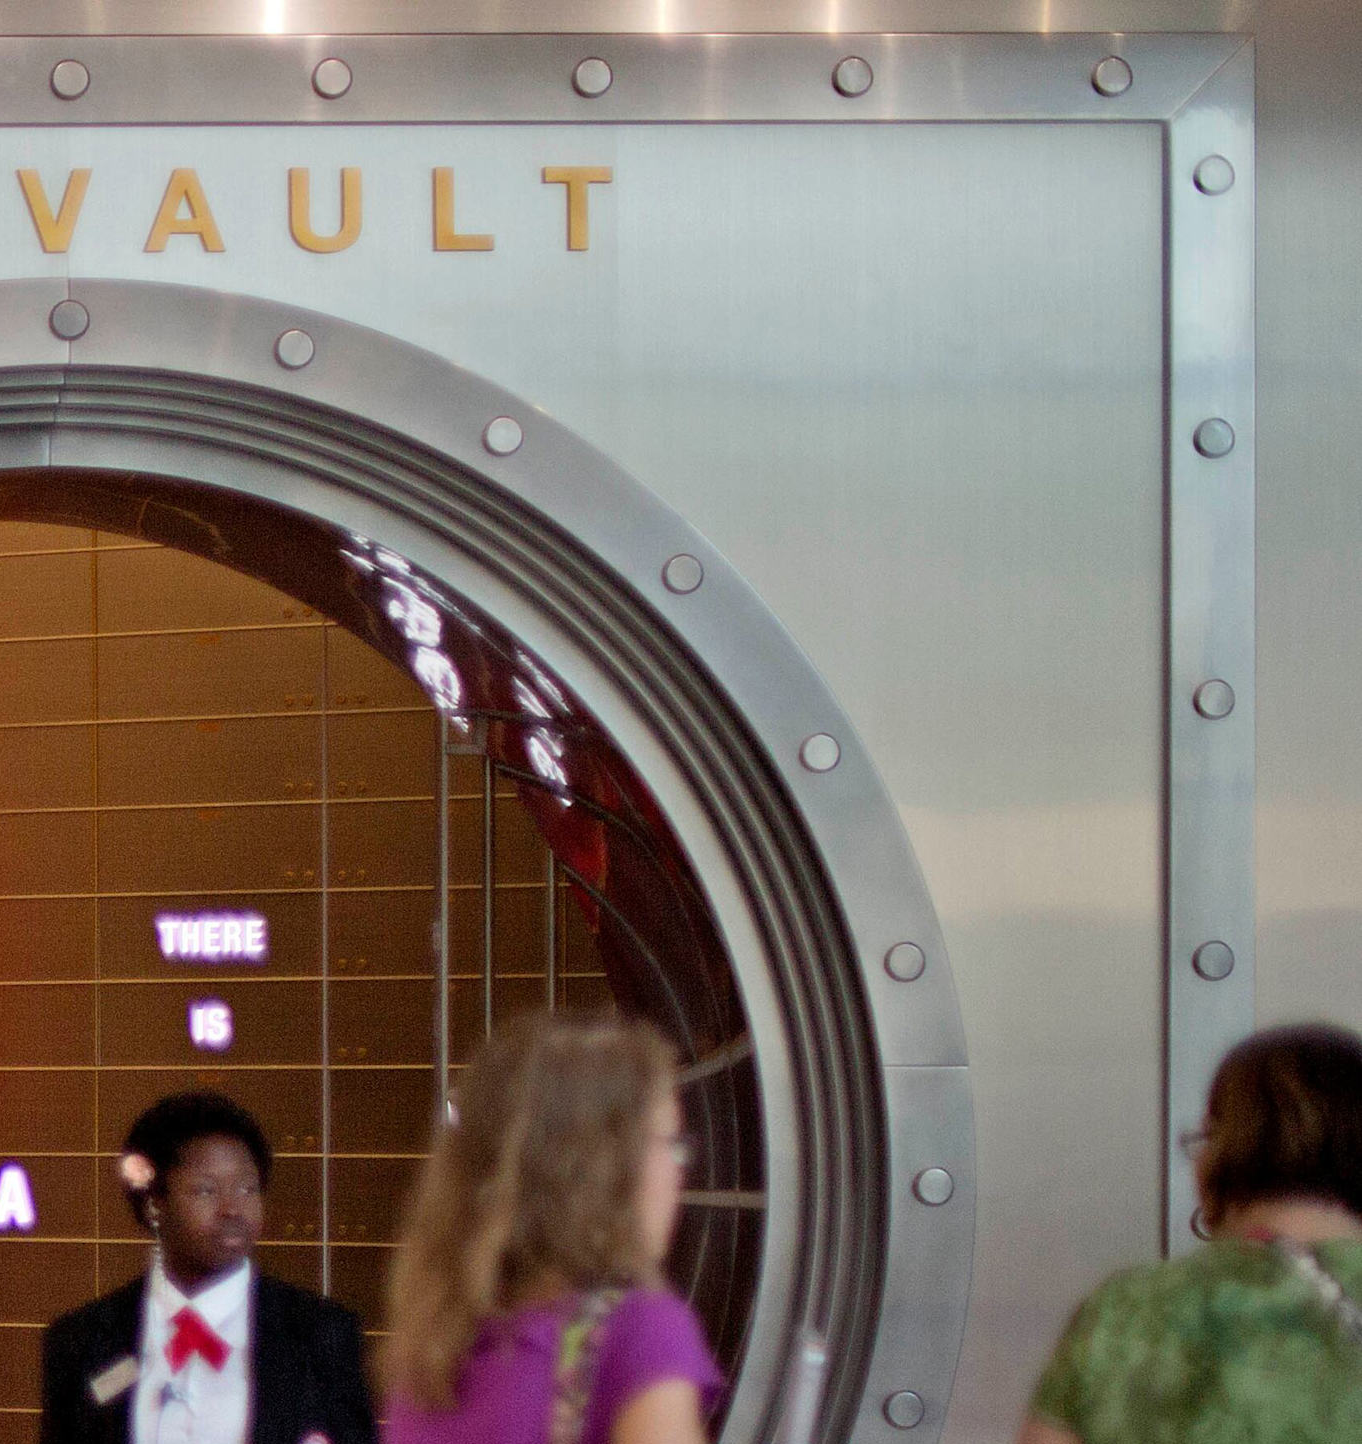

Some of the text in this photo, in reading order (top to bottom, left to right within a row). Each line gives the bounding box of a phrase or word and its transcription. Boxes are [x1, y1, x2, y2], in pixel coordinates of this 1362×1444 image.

[20, 168, 610, 252] VAULT
[156, 914, 266, 960] THERE
[190, 1003, 232, 1046] IS
